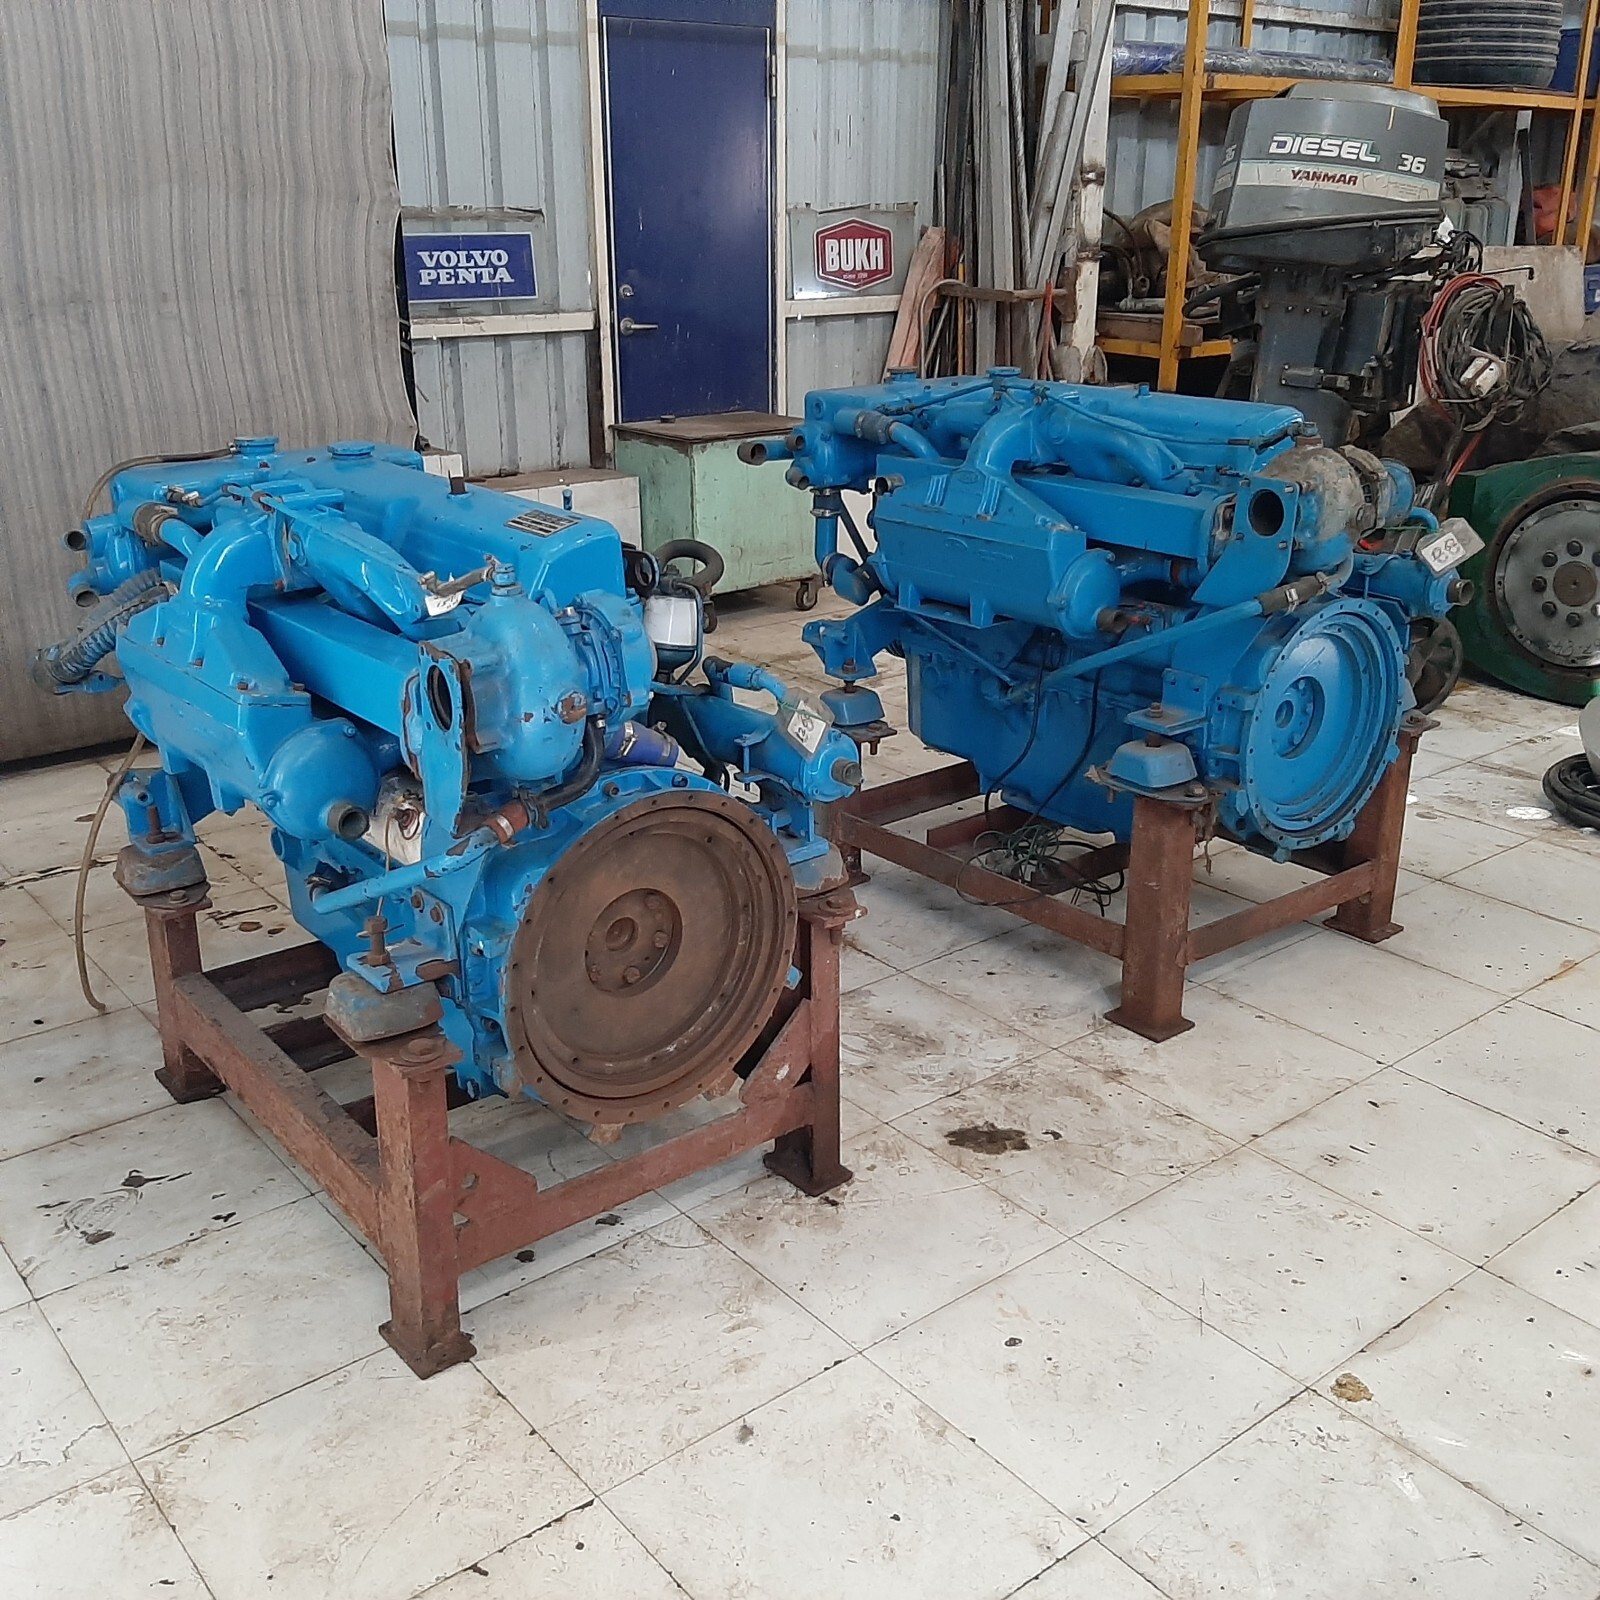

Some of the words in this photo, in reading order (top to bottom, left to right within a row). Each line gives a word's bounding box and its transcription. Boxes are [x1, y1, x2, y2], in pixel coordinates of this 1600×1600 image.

[1269, 136, 1381, 163] DIESEL
[1397, 154, 1427, 174] 36
[1291, 169, 1359, 187] YANMAR
[417, 249, 509, 268] VOLVO
[824, 238, 885, 272] BUKH
[419, 267, 515, 286] PENTA
